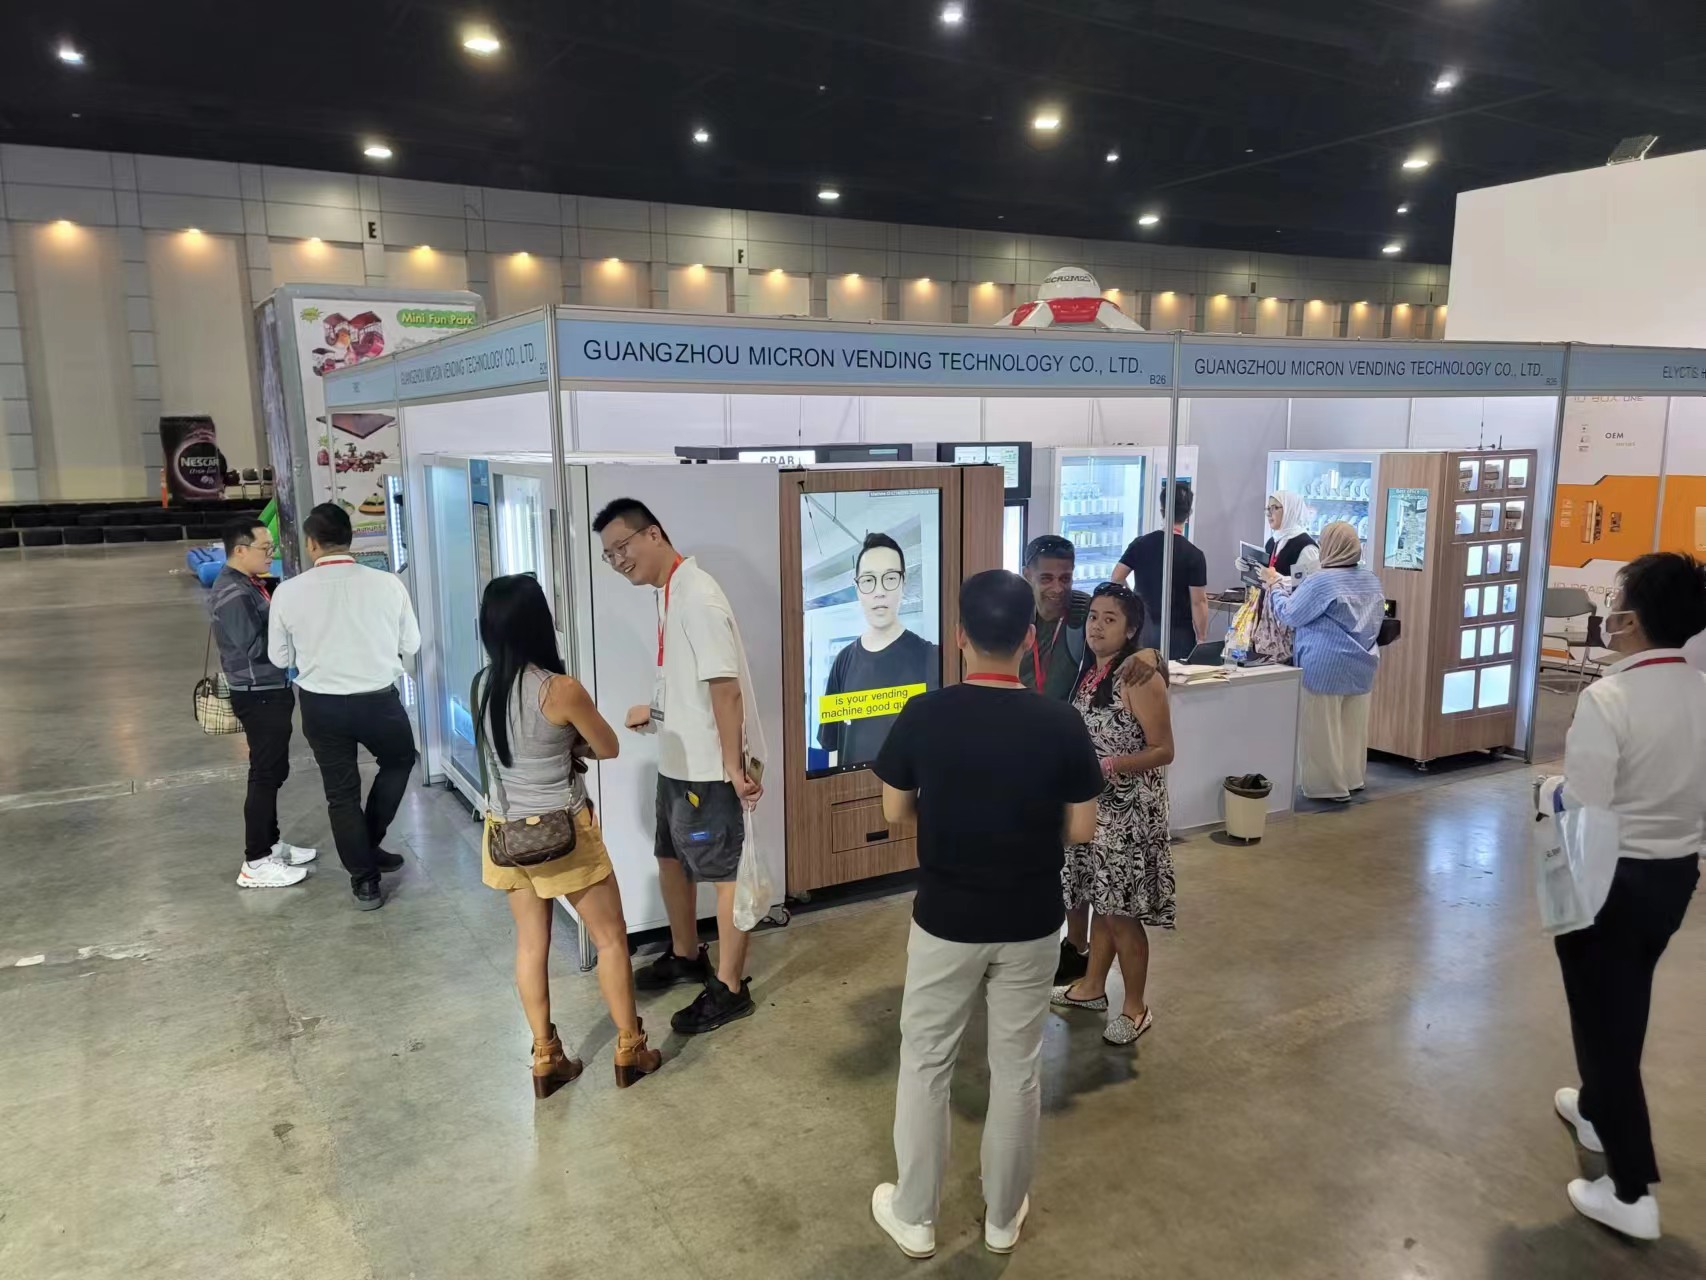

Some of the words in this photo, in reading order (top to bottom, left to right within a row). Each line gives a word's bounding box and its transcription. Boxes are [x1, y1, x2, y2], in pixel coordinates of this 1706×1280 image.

[368, 222, 377, 239] E
[737, 249, 744, 264] F
[401, 312, 425, 323] Mini
[429, 313, 447, 324] Fun
[450, 314, 474, 325] Park
[465, 350, 503, 375] TECHNOLOGY
[520, 342, 537, 363] LTD.
[583, 339, 740, 365] GUANGZHOU
[749, 346, 835, 368] MICRON
[842, 349, 932, 370] VENDING
[939, 352, 1064, 373] TECHNOLOGY
[1069, 356, 1103, 376] CO.,
[1109, 357, 1143, 374] LTD.
[1194, 358, 1287, 375] GUANGZHOU
[1291, 360, 1345, 376] MICRON
[1349, 360, 1406, 376] VENDING
[1410, 361, 1491, 376] TECHNOLOGY
[1520, 363, 1544, 377] LTD.
[1149, 374, 1167, 385] B26
[835, 696, 844, 706] is
[846, 694, 868, 707] your
[871, 689, 908, 701] vending
[821, 706, 863, 719] machine
[866, 701, 890, 715] good
[893, 701, 905, 713] qu
